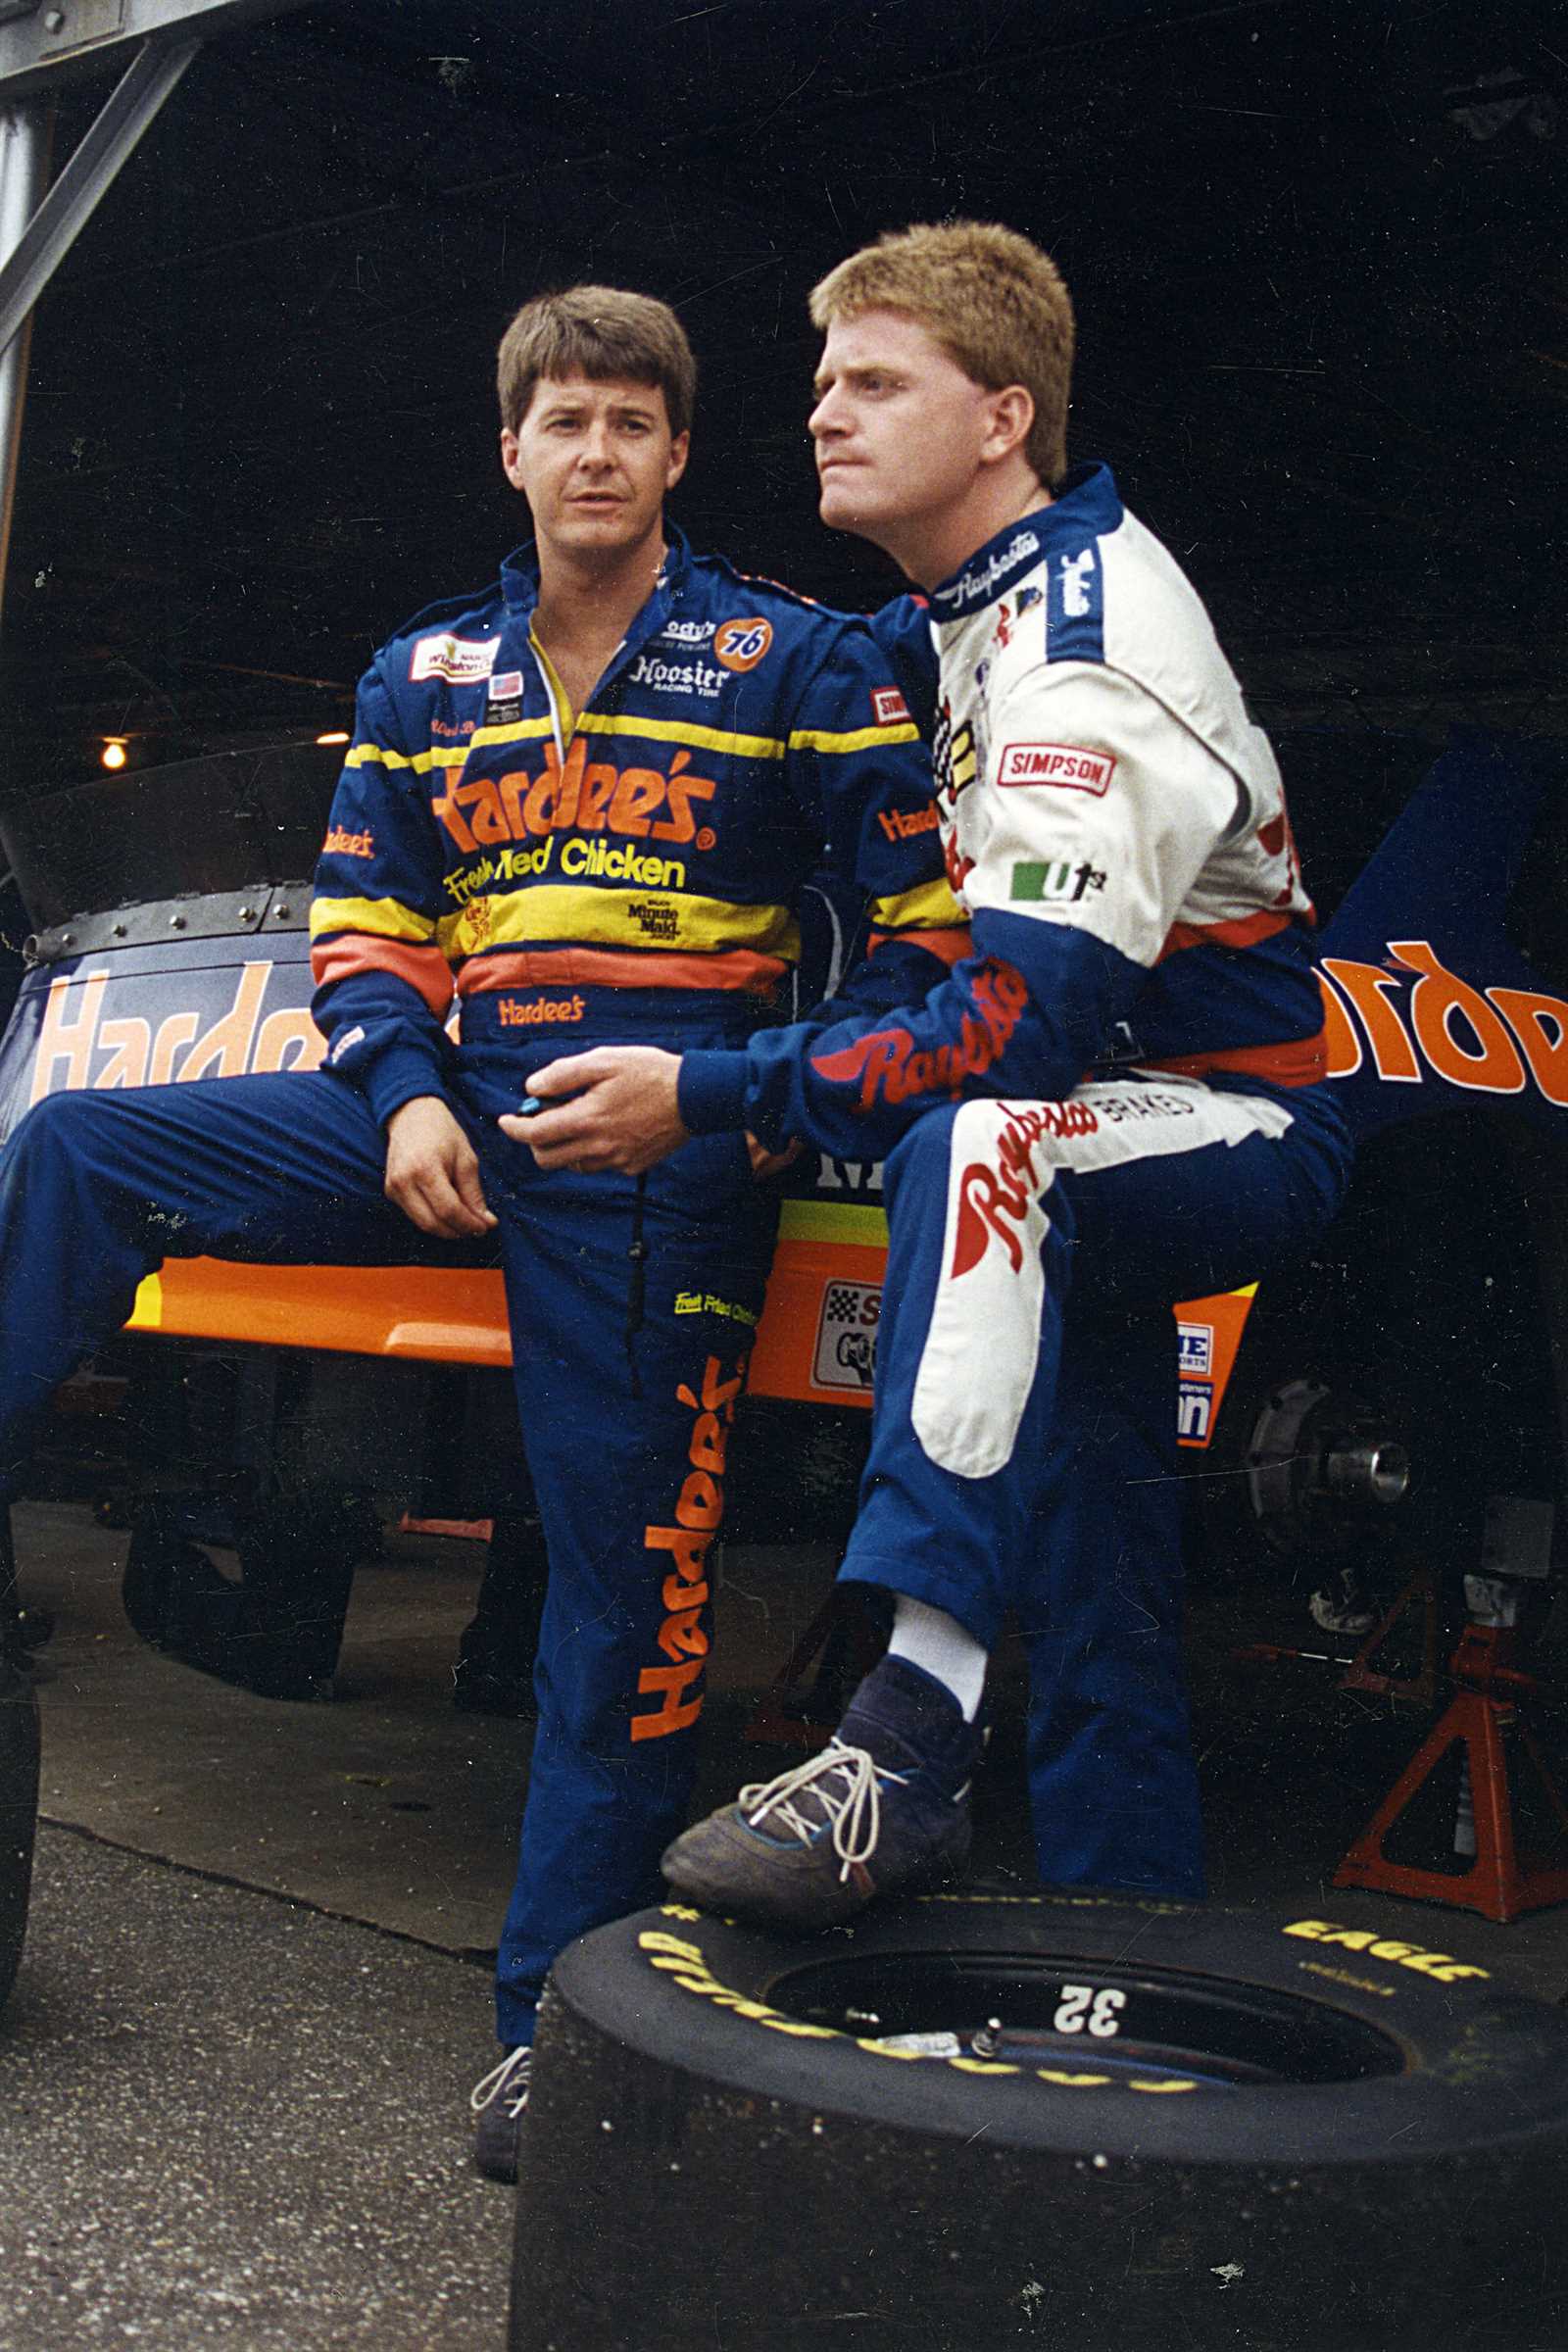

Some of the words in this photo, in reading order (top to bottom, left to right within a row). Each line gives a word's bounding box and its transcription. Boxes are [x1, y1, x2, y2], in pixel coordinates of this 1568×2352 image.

[720, 624, 767, 659] 76
[628, 656, 730, 687] Hoosier
[653, 683, 692, 694] RACING
[698, 688, 719, 697] TIRE
[1011, 754, 1104, 783] SIMPSON
[561, 838, 685, 888] Chicken
[499, 995, 585, 1026] Hardee's
[630, 1355, 745, 1742] Hardee's
[1282, 1919, 1492, 1984] EAGLE
[1054, 1984, 1127, 2038] 32
